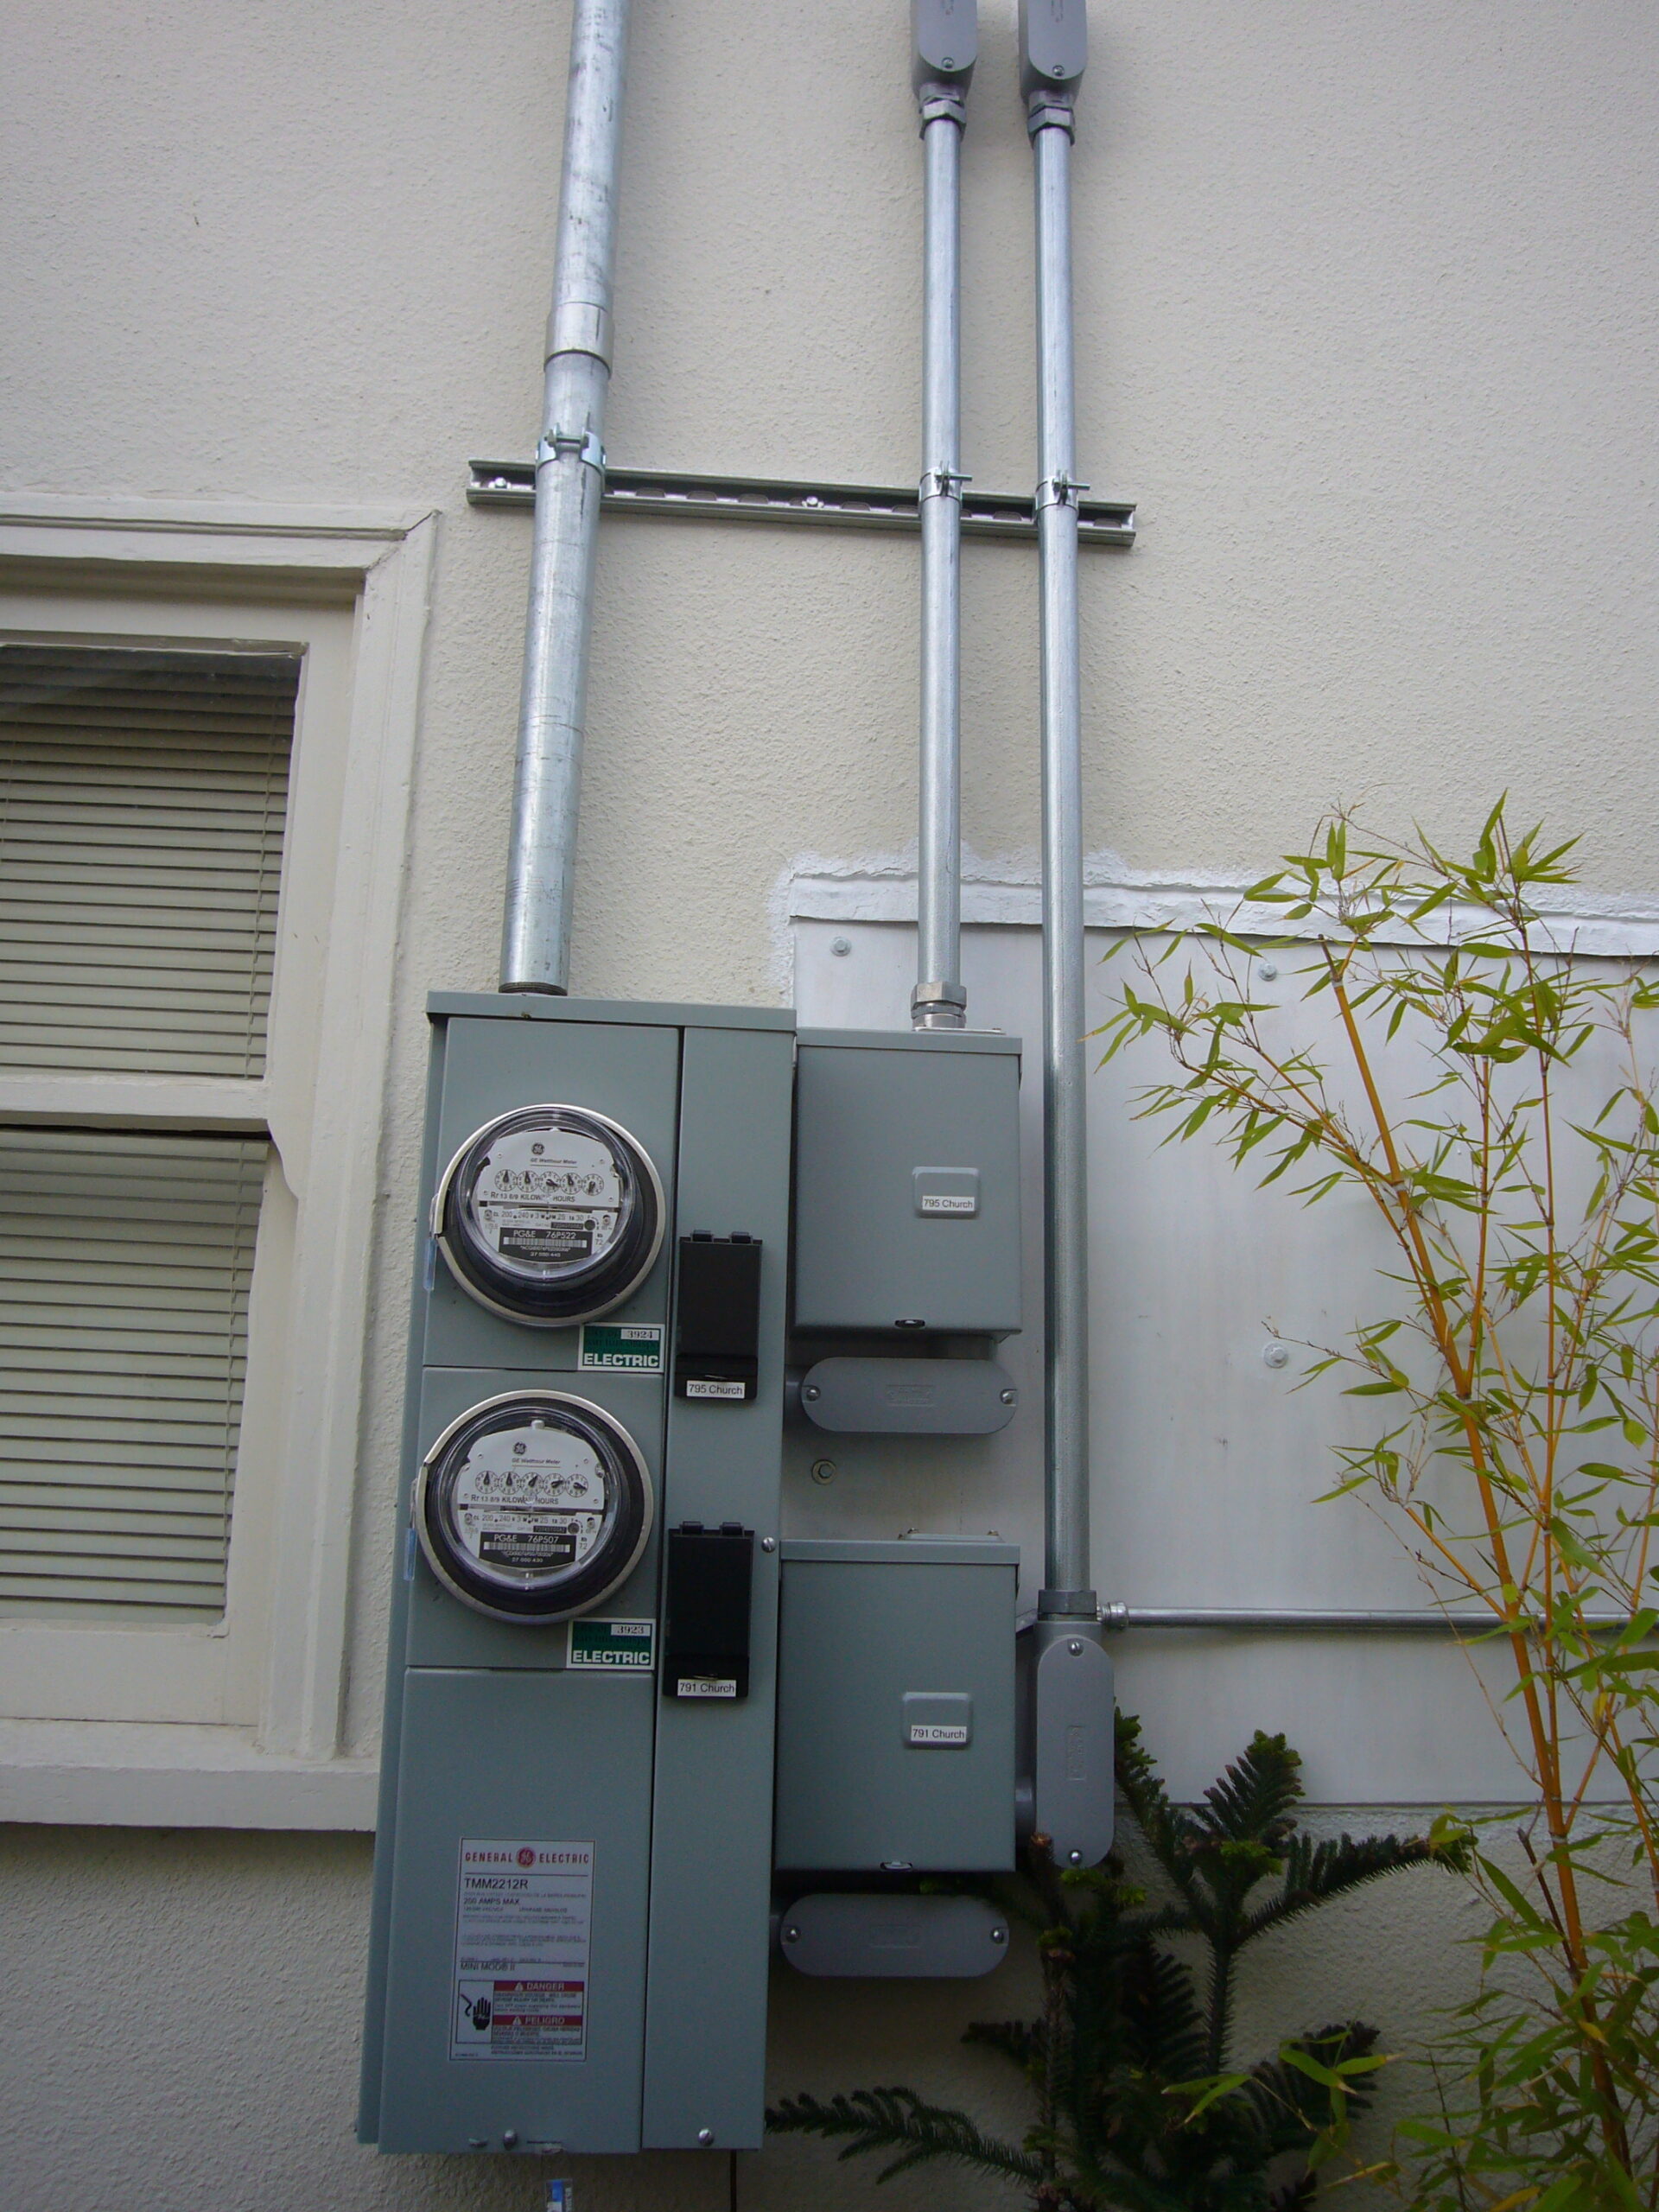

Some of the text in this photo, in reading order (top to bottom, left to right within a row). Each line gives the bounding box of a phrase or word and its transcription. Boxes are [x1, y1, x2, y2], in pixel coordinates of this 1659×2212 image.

[924, 1198, 973, 1209] 795 Church
[583, 1352, 659, 1368] ELECTRIC
[689, 1383, 743, 1395] 795 Church
[494, 1534, 559, 1544] PG&E 76P507
[572, 1650, 650, 1664] ELECTRIC
[679, 1682, 734, 1694] 791 Church
[912, 1728, 965, 1739] 791 Church
[465, 1852, 512, 1862] GENERAL
[539, 1853, 589, 1864] ELECTRIC
[464, 1878, 529, 1890] TMM2212R
[479, 1897, 501, 1906] AMPS
[526, 1982, 565, 1991] DANGER
